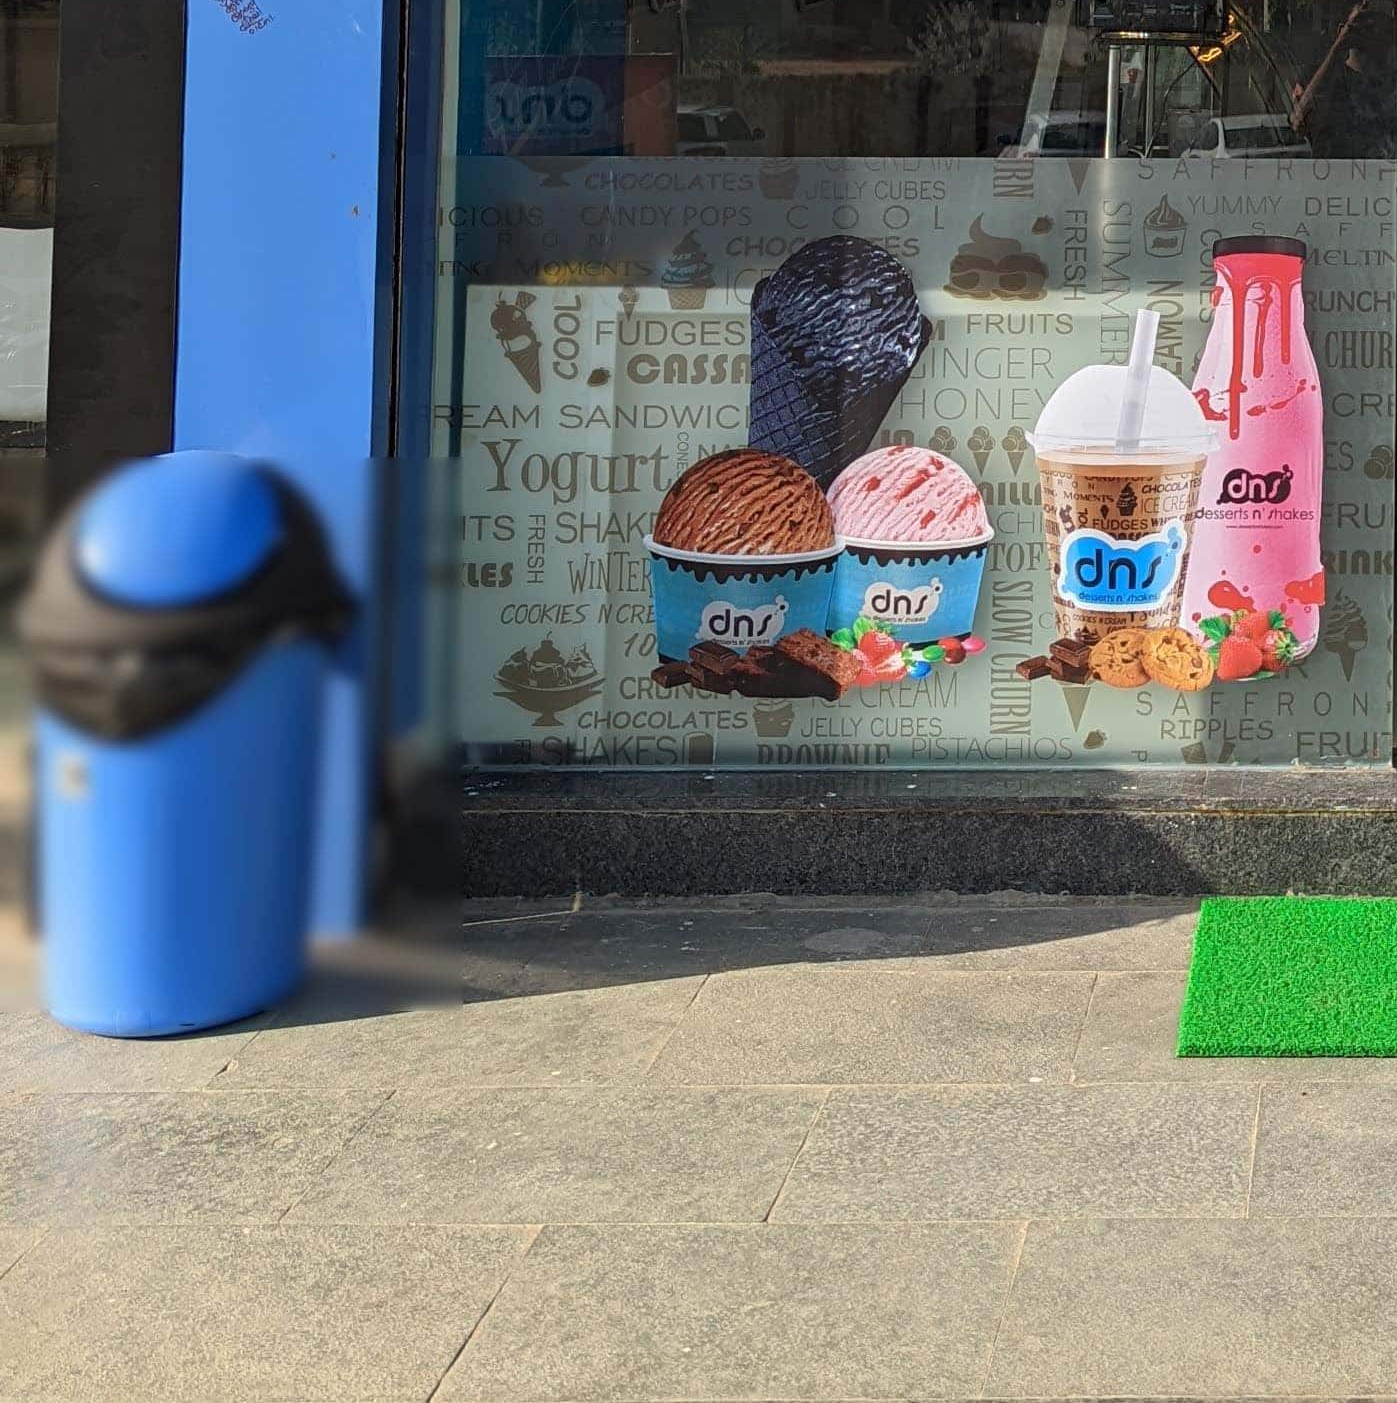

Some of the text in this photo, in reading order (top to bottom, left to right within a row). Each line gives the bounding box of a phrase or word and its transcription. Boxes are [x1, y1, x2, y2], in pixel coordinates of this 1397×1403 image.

[583, 172, 754, 192] CHOCOLATES
[1137, 158, 1367, 181] SAFFRON
[873, 180, 947, 200] CUBES
[580, 205, 753, 229] CANDY POPS
[785, 205, 945, 230] COOL
[1187, 195, 1282, 216] YUMMY
[1063, 210, 1088, 301] FRESH
[1100, 200, 1133, 365] SUMMER
[595, 320, 746, 347] FUDGES
[966, 313, 1075, 335] FRUITS
[552, 294, 582, 381] COOL
[480, 438, 671, 506] Yogurt
[1092, 518, 1149, 531] FUDGES
[1194, 507, 1249, 520] desserts
[1268, 507, 1316, 521] shakes
[526, 513, 547, 584] FRESH
[1074, 549, 1162, 590] dns
[500, 603, 592, 625] COOKIES
[871, 589, 928, 615] dns
[709, 609, 773, 638] dns
[989, 580, 1034, 736] SLOW CHURN
[1135, 690, 1369, 717] SAFFRON
[577, 709, 749, 730] CHOCOLATES
[800, 717, 943, 739] JELLY CUBES
[1160, 718, 1274, 741] RIPPLES
[541, 735, 679, 765] SHAKES
[911, 736, 1073, 763] PISTACHIOS
